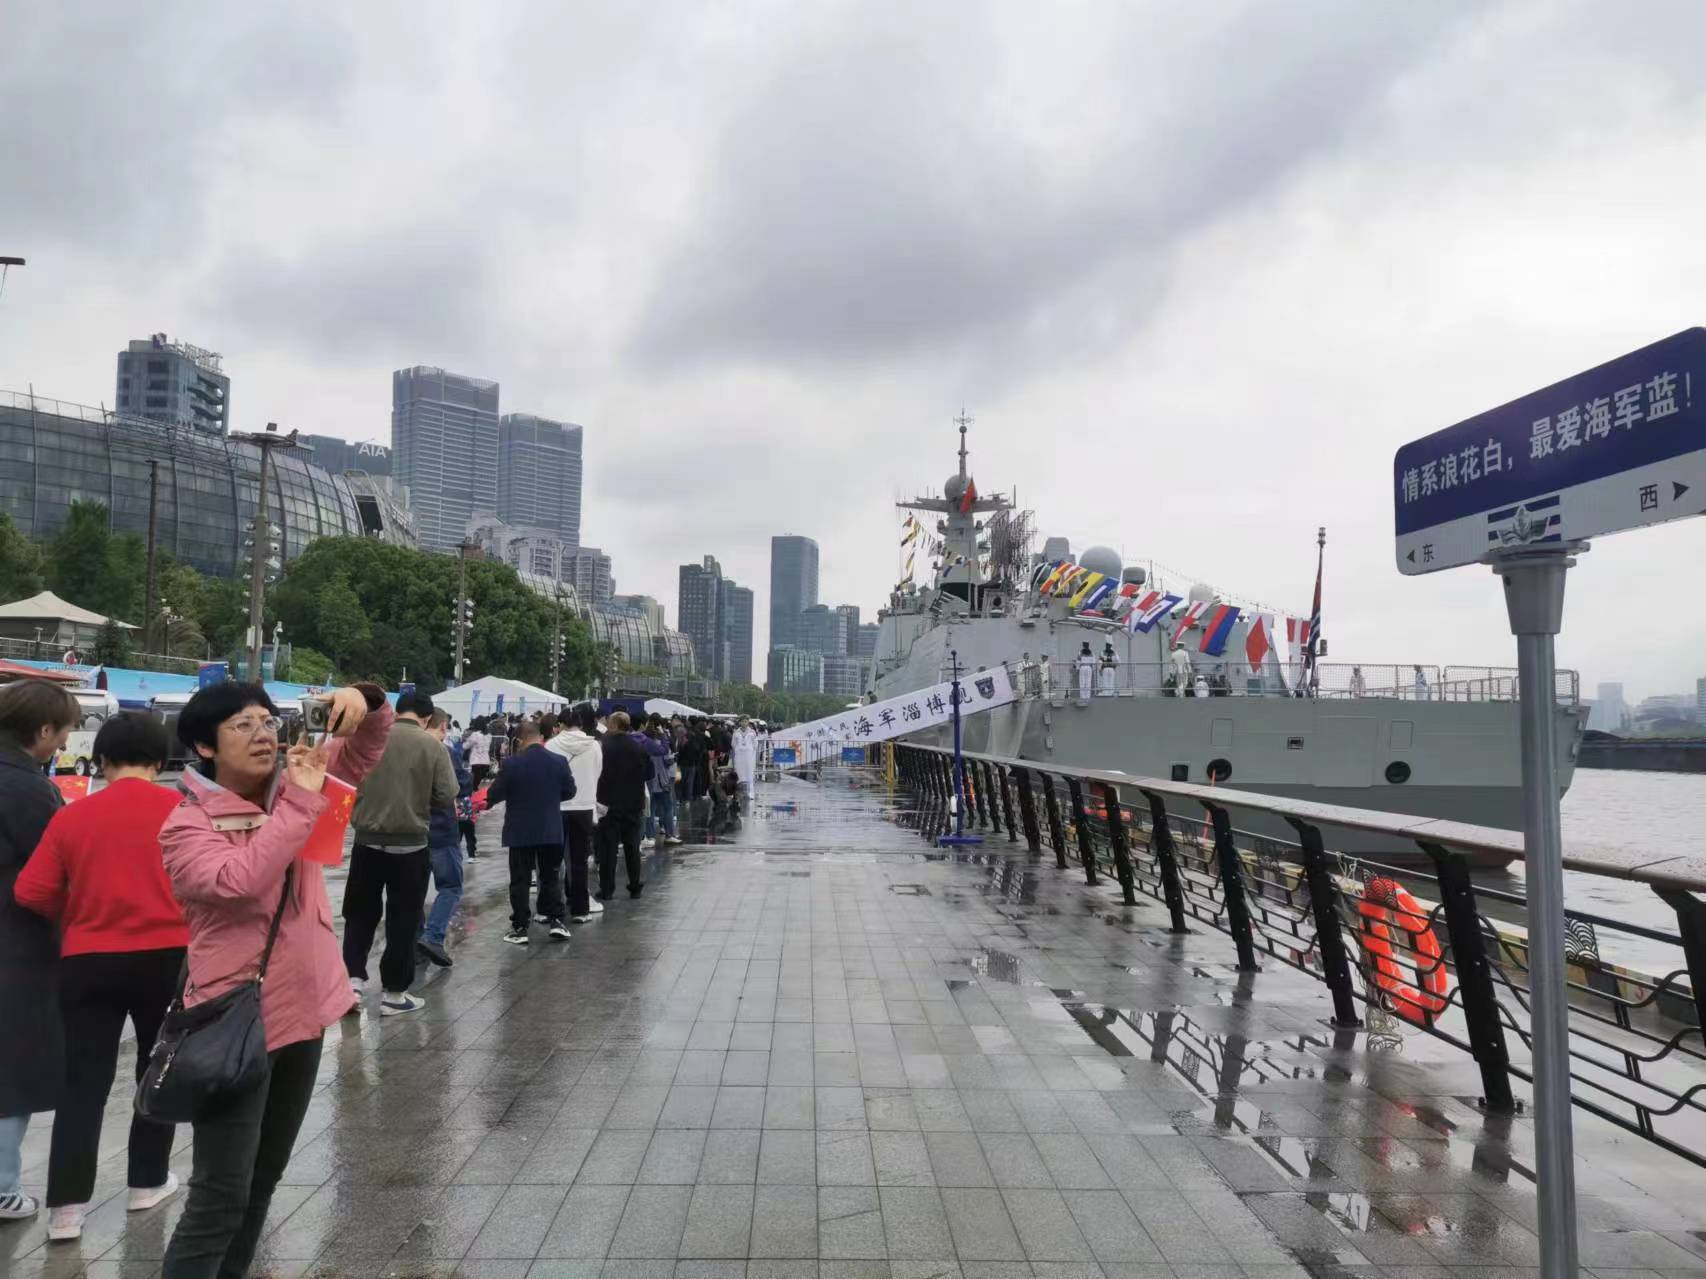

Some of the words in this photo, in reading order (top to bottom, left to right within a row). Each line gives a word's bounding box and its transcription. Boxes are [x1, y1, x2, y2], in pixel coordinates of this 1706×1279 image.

[359, 443, 387, 459] AIA
[1640, 484, 1659, 512] 西
[1422, 544, 1434, 563] 东
